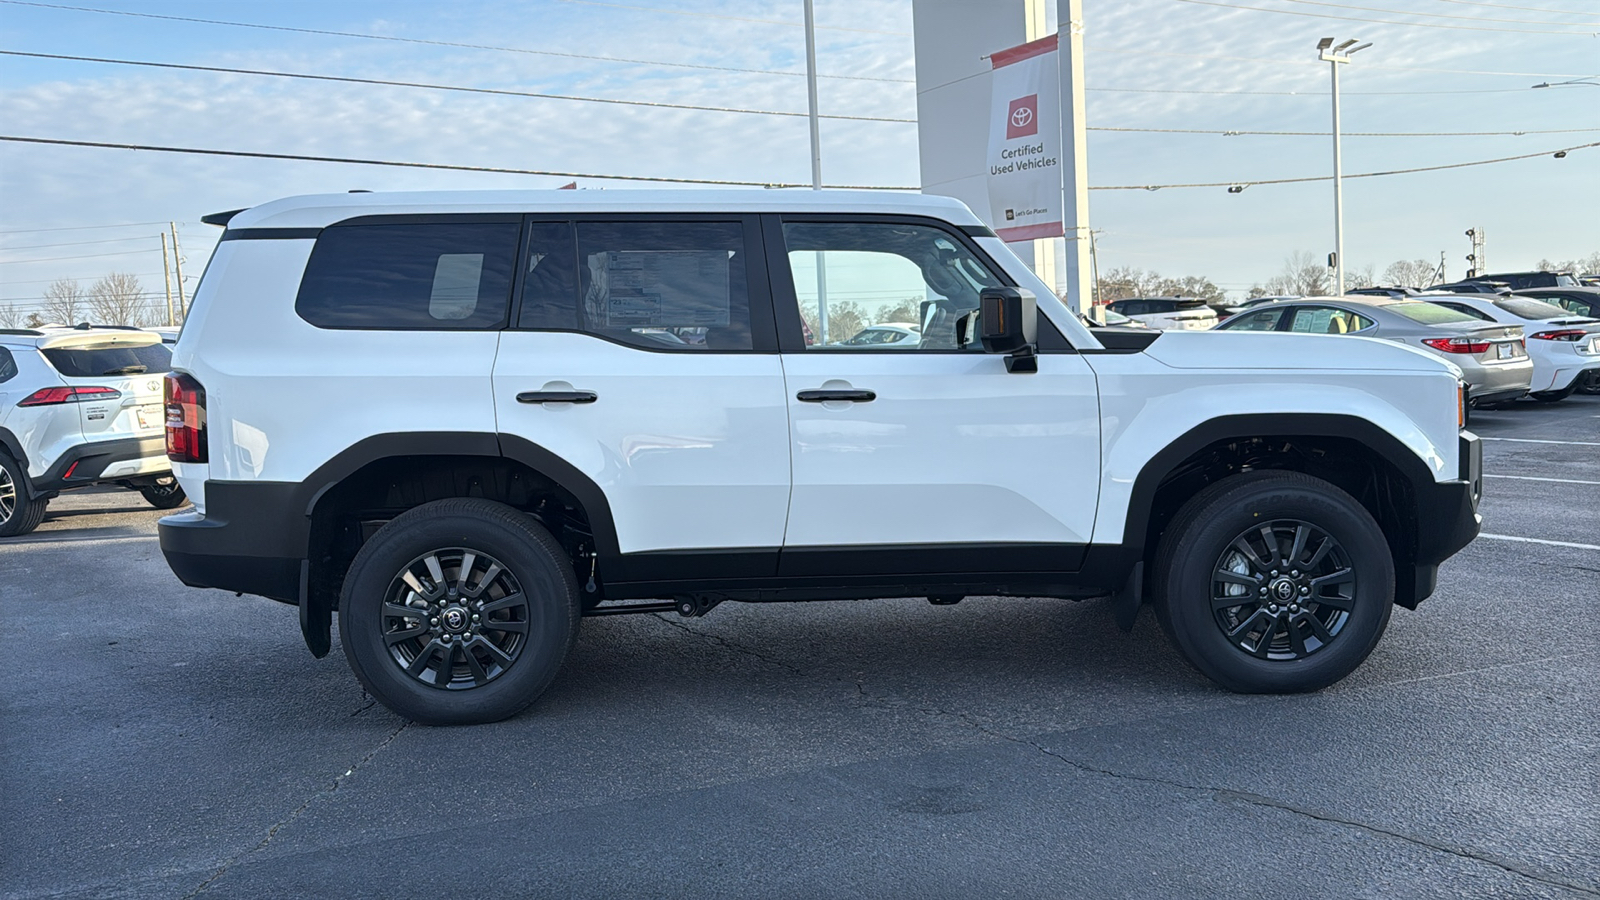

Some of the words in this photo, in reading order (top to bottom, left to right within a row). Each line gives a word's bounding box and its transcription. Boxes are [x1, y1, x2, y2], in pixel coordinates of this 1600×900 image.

[1001, 142, 1043, 159] Certified
[991, 162, 1014, 175] Used
[1015, 156, 1057, 171] Vehicles
